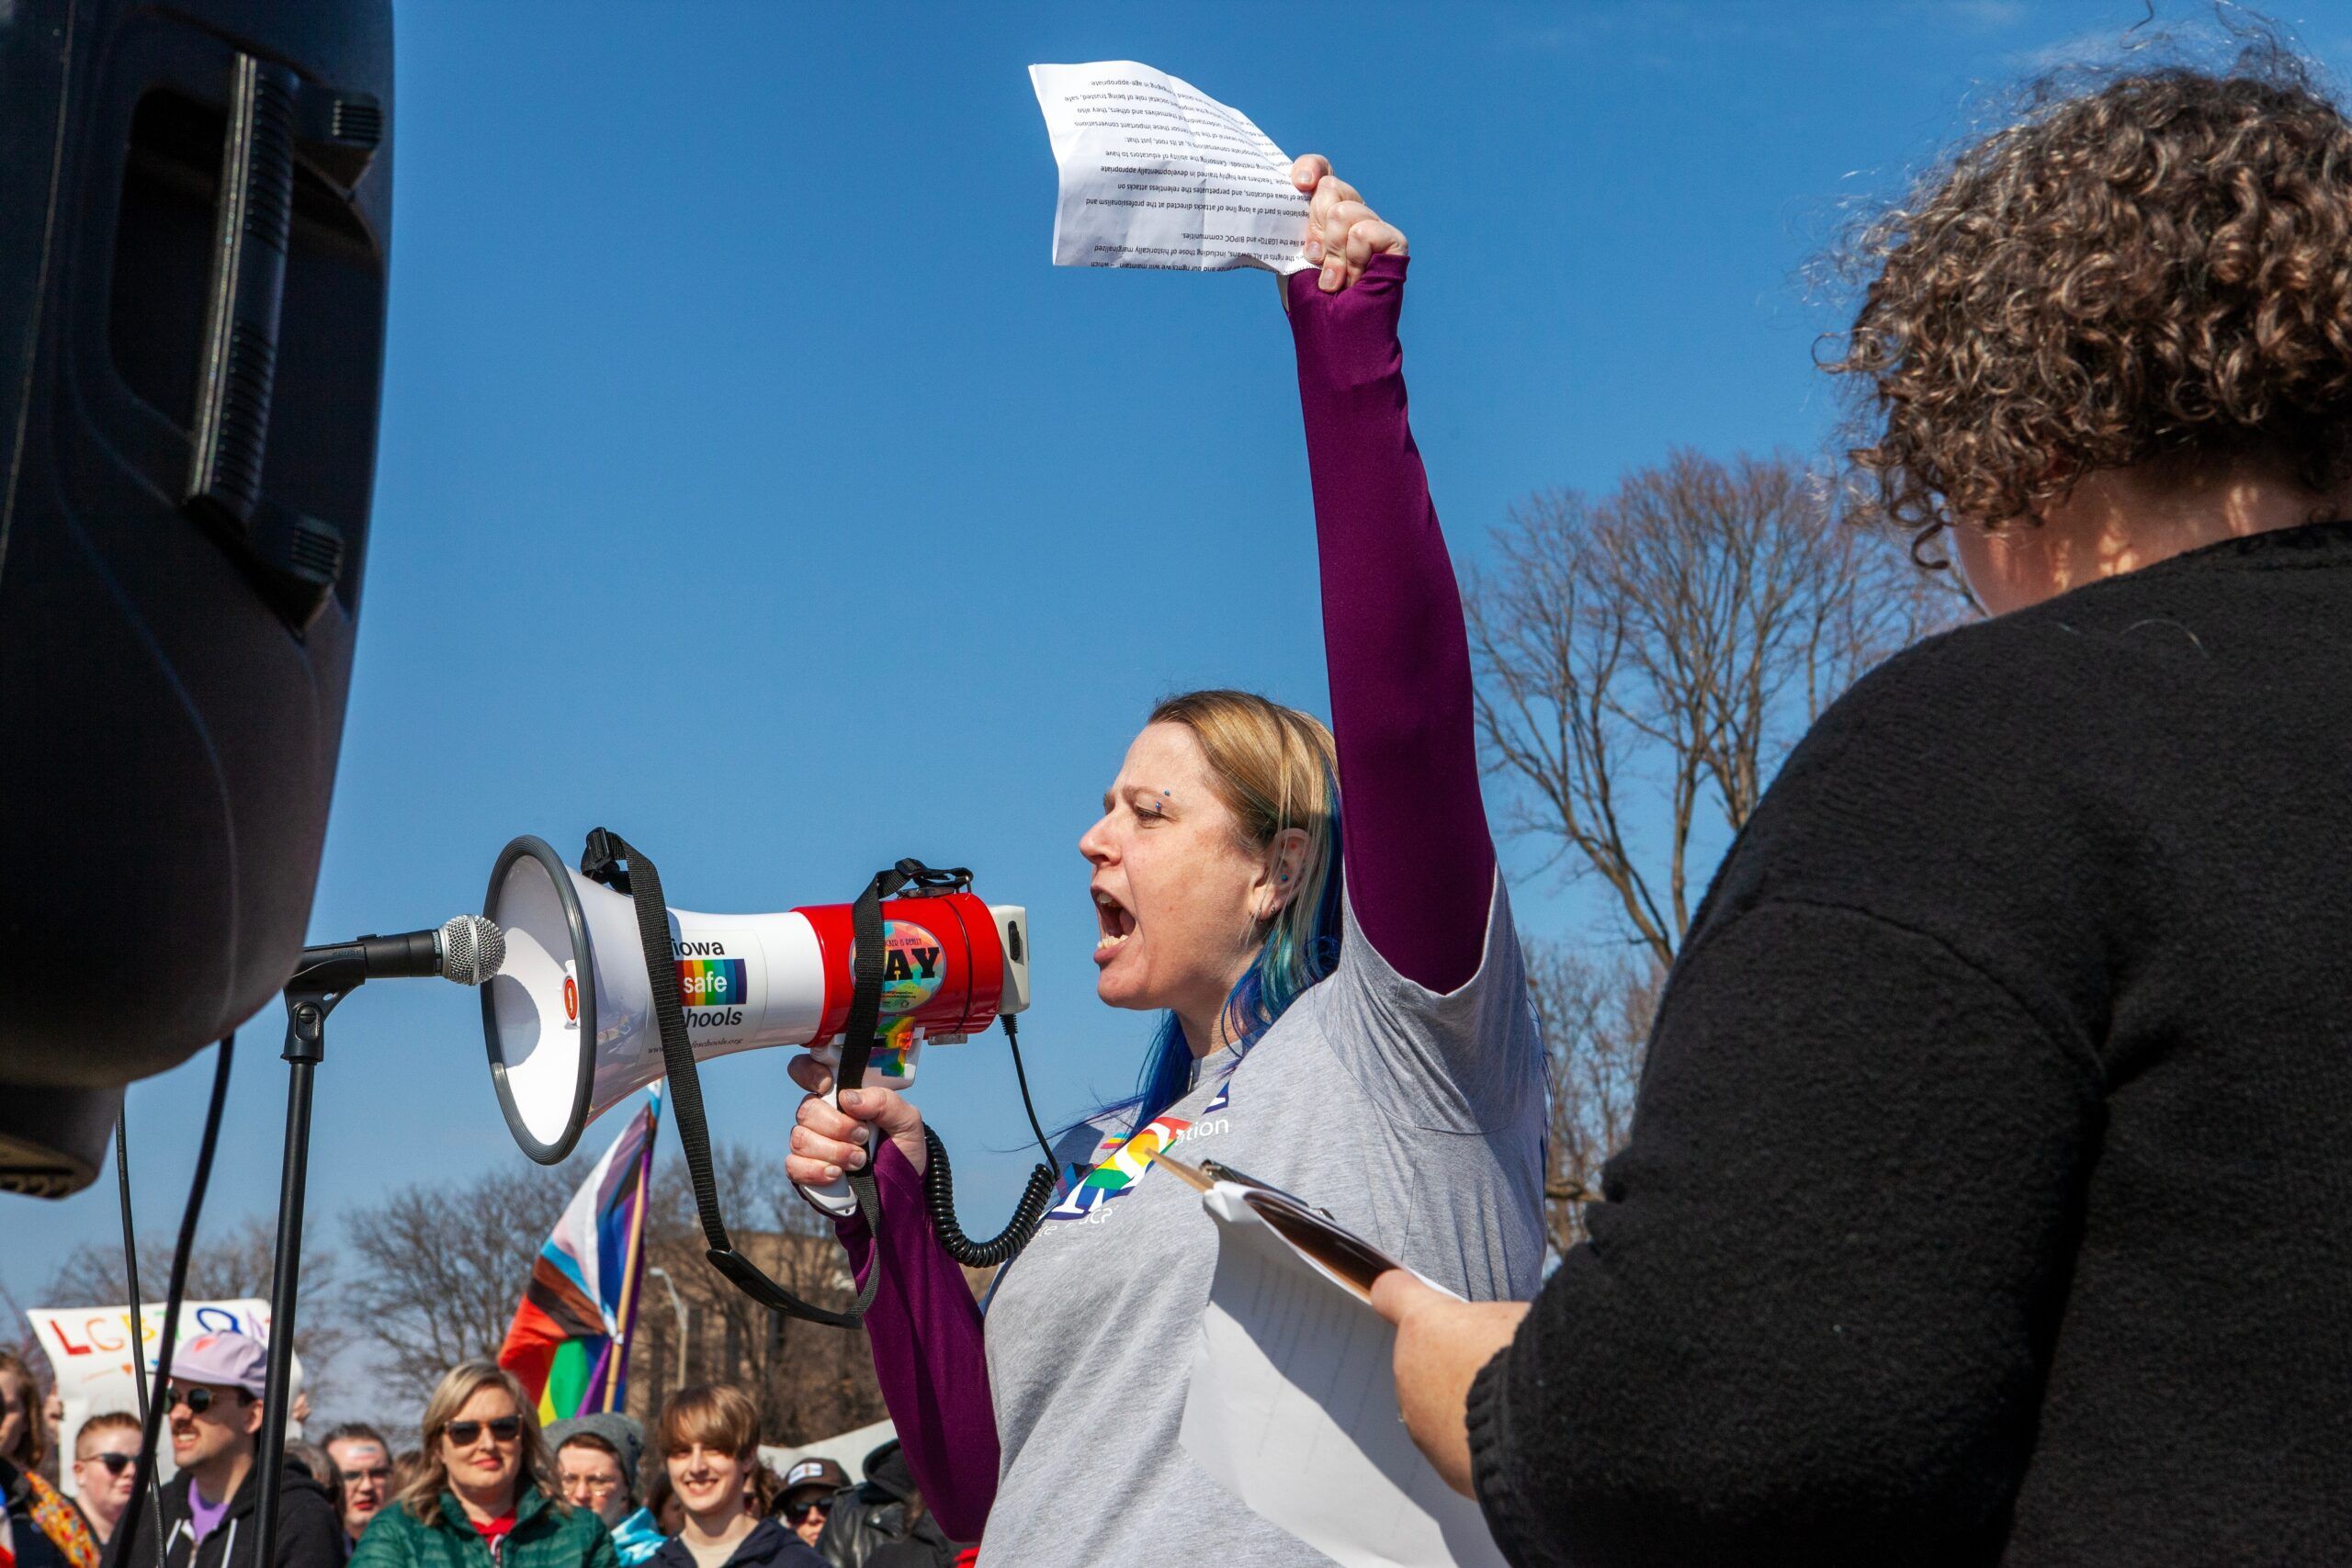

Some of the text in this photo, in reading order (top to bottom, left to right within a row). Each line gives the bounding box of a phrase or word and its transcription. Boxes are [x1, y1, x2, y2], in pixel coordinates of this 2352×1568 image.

[1108, 107, 1129, 115] others,
[1121, 122, 1151, 130] important
[1138, 167, 1188, 178] developmentally
[1244, 190, 1273, 198] educators,
[1099, 199, 1144, 208] professionalism
[1283, 210, 1309, 219] legislation
[1182, 232, 1223, 241] communities.
[1136, 246, 1169, 255] historically
[1196, 249, 1226, 257] including
[671, 939, 725, 956] iowa
[884, 947, 940, 981] AY
[683, 971, 728, 994] safe
[685, 1007, 743, 1029] hools
